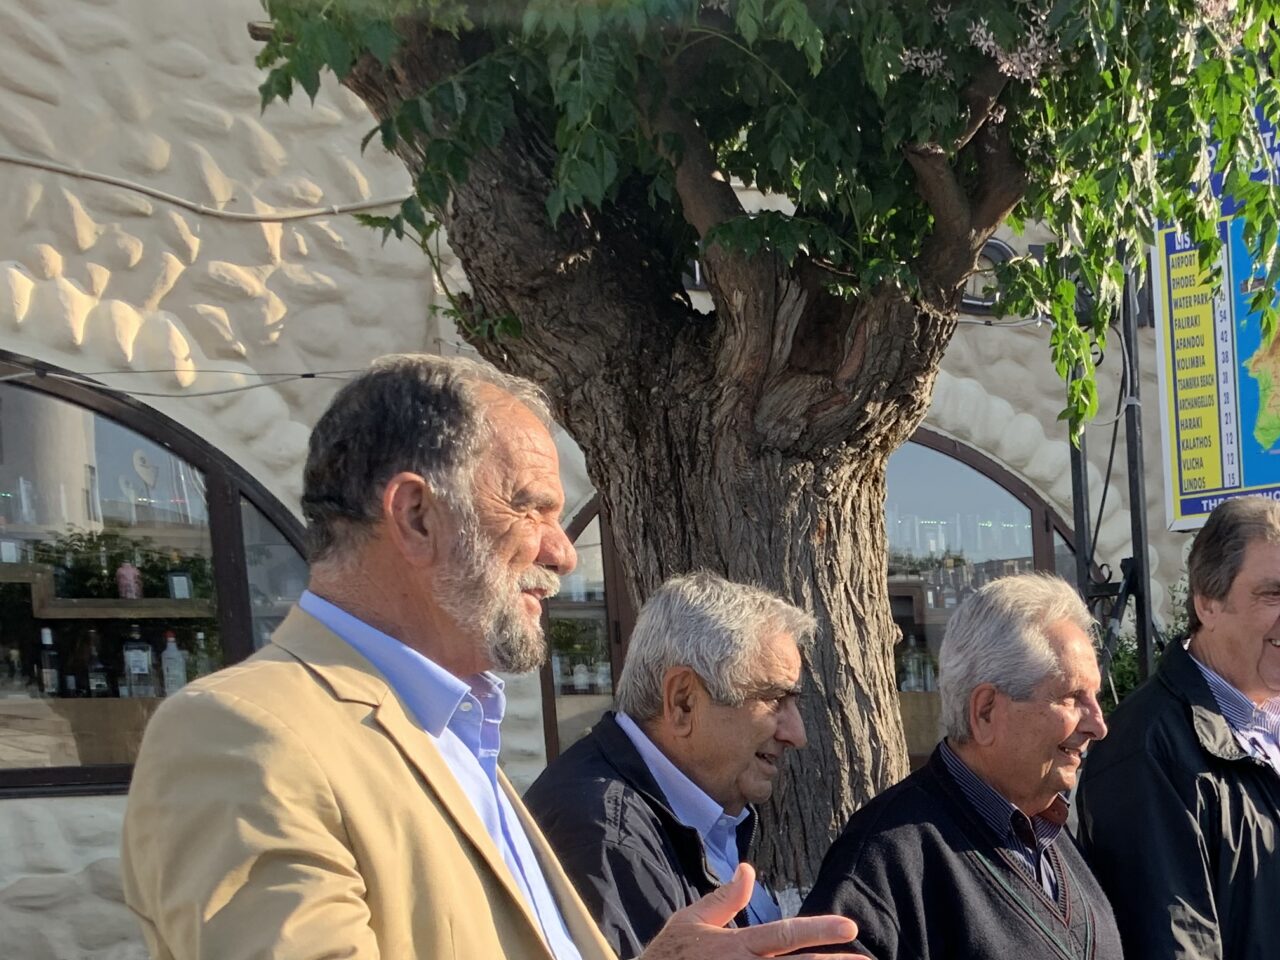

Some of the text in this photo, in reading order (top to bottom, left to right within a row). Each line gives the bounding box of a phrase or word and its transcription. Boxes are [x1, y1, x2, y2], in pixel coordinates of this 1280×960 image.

[1175, 231, 1194, 250] LIS
[1171, 253, 1196, 269] AIRPORT
[1171, 274, 1196, 290] RHODES
[1173, 295, 1193, 310] WATER
[1174, 314, 1201, 330] FALIRAKI
[1175, 335, 1205, 351] AFANDOU
[1177, 355, 1206, 371] KOLIMBIA
[1180, 412, 1232, 431] HARAKI 21
[1181, 432, 1234, 451] KALATHOS 12
[1182, 453, 1234, 471] VLICHA 12
[1183, 477, 1206, 491] LINDOS
